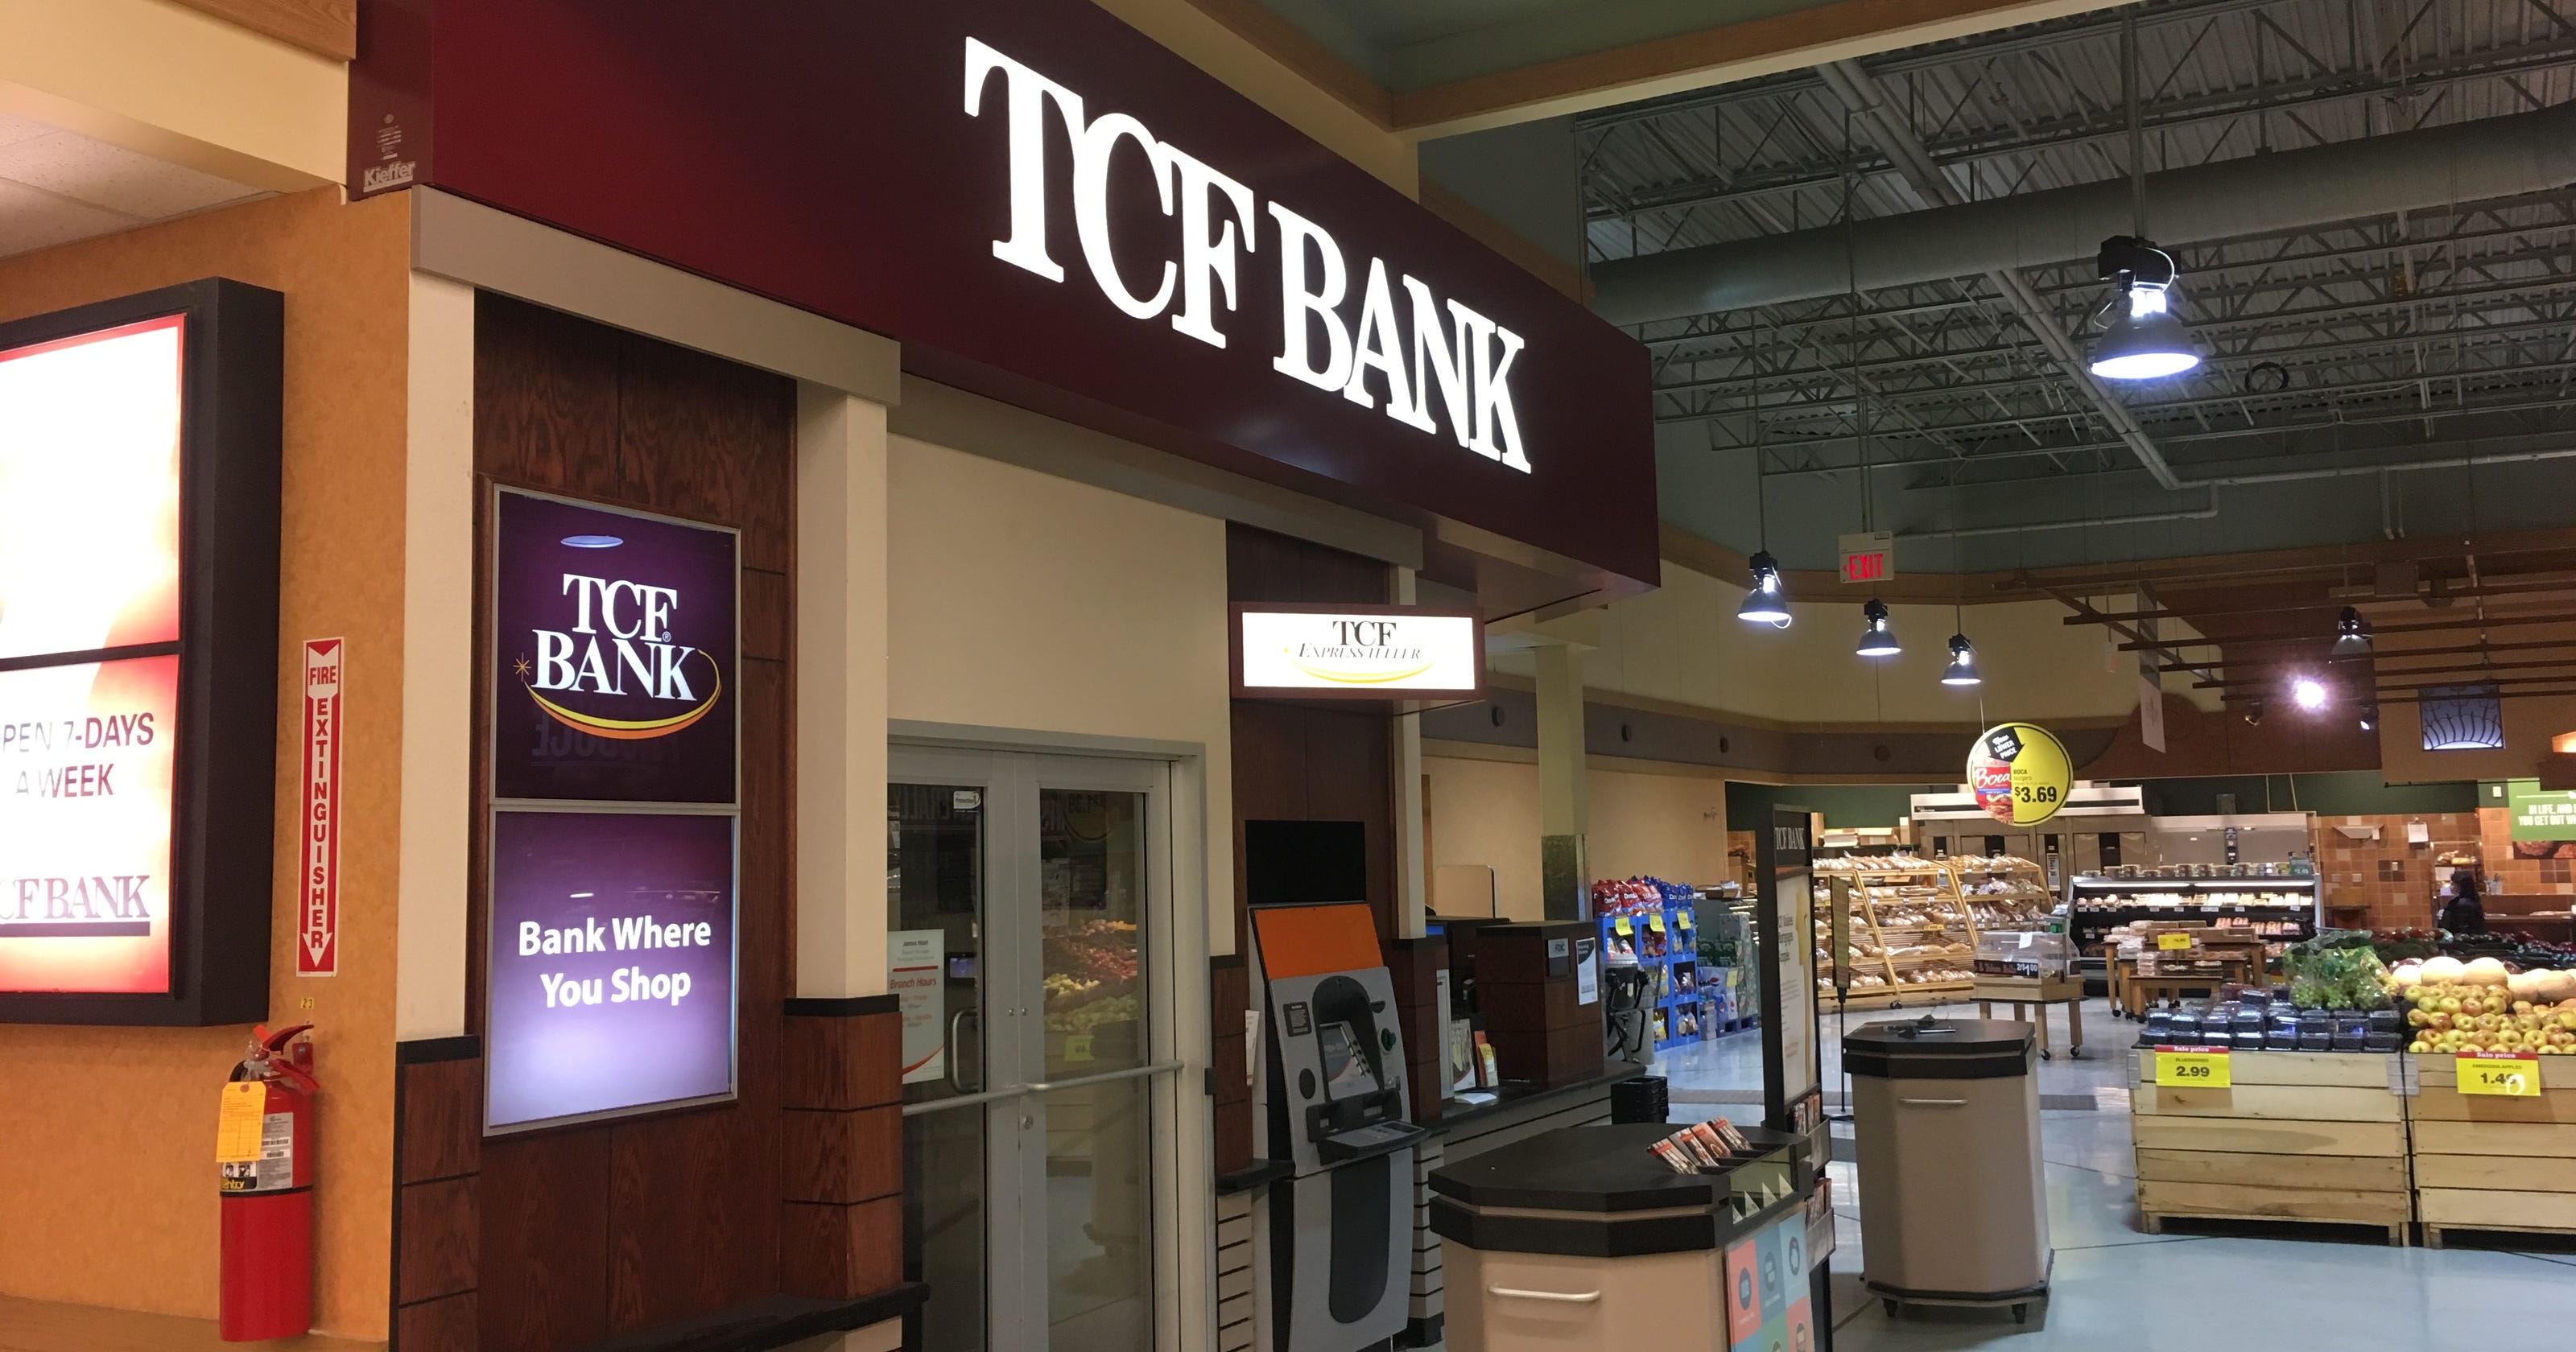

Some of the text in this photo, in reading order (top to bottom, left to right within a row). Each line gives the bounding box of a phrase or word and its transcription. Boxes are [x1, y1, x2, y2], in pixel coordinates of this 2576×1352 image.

[363, 161, 415, 187] Kieffer
[965, 36, 1531, 474] TCF BANK
[1849, 553, 1884, 579] EXIT
[564, 573, 677, 642] TCF
[1332, 620, 1397, 646] TCF
[309, 665, 336, 686] FIRE
[530, 629, 698, 701] BANK
[2, 712, 155, 752] PEN 7-DAYS
[1994, 740, 2015, 753] LOWER
[2000, 747, 2017, 759] PRICE
[16, 764, 114, 798] A WEEK
[1976, 767, 2010, 788] Boca
[2014, 786, 2057, 803] $3.69
[311, 698, 328, 948] EXTINGUISHER
[2518, 815, 2533, 826] YOU
[2534, 814, 2549, 826] GET
[2550, 814, 2566, 826] OUT
[1774, 826, 1805, 851] TCF BANK
[0, 875, 151, 920] CF BANK
[519, 915, 711, 956] Bank Where
[539, 966, 691, 1008] You Shop
[890, 977, 937, 989] Branch Hours
[302, 998, 313, 1008] 23
[2176, 1066, 2210, 1077] 2.99
